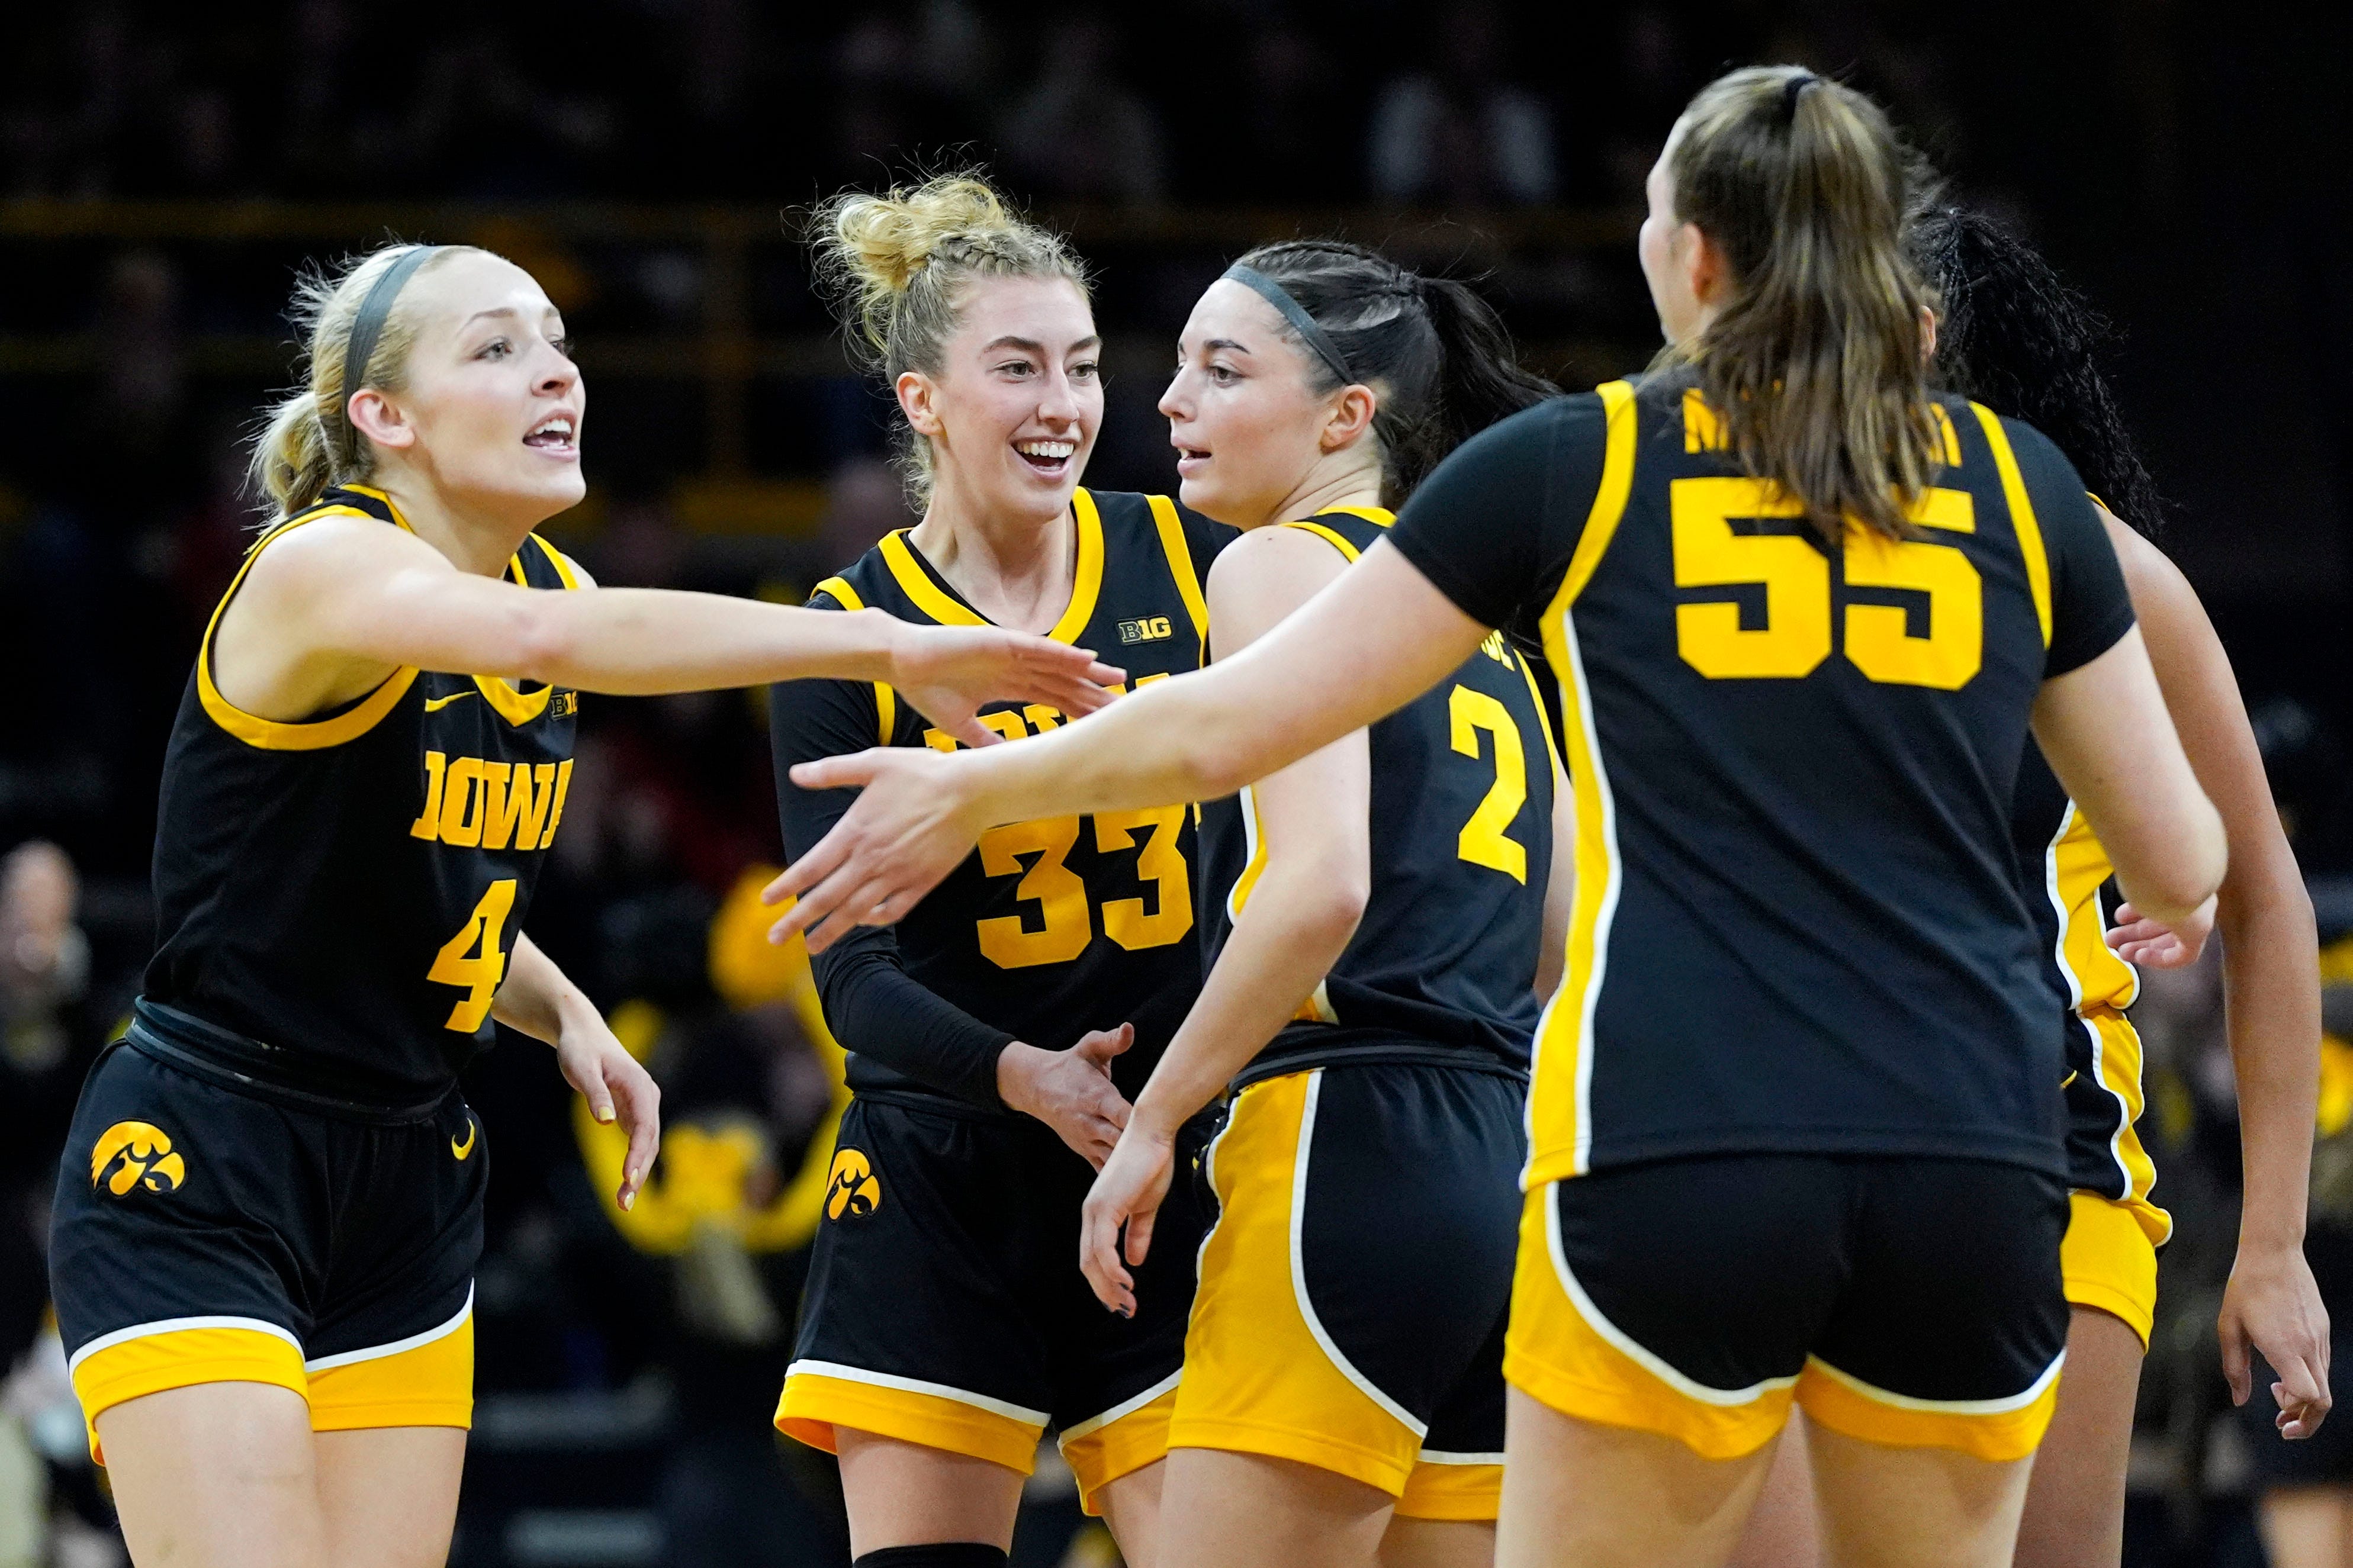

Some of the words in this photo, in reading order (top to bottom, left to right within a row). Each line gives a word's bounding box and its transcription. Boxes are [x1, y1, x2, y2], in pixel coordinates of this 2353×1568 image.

[1670, 476, 1982, 691] 55
[1448, 683, 1527, 886] 2
[426, 878, 517, 1033] 4
[976, 803, 1194, 970] 33
